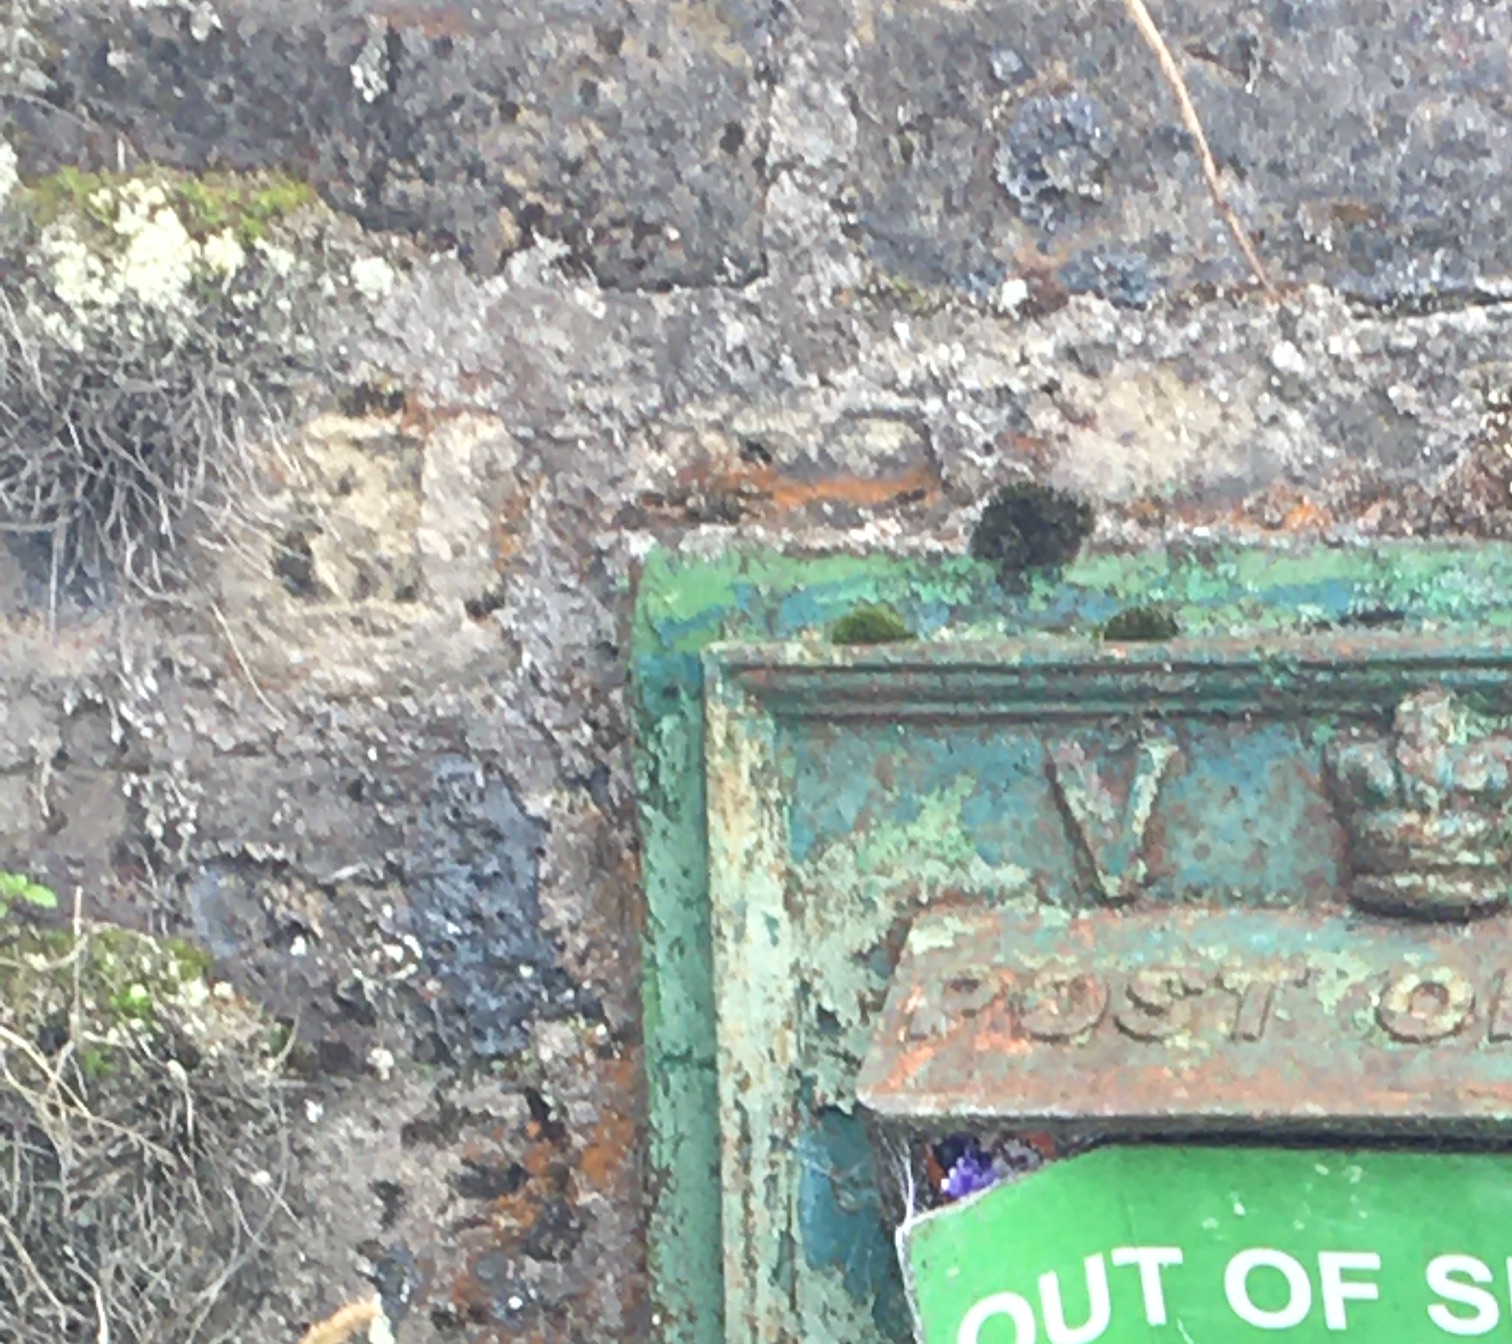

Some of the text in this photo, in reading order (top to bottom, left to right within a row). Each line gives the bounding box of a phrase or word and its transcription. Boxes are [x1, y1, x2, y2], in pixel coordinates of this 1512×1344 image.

[1042, 738, 1184, 904] V
[897, 967, 1310, 1045] POST
[1224, 1247, 1382, 1329] OF
